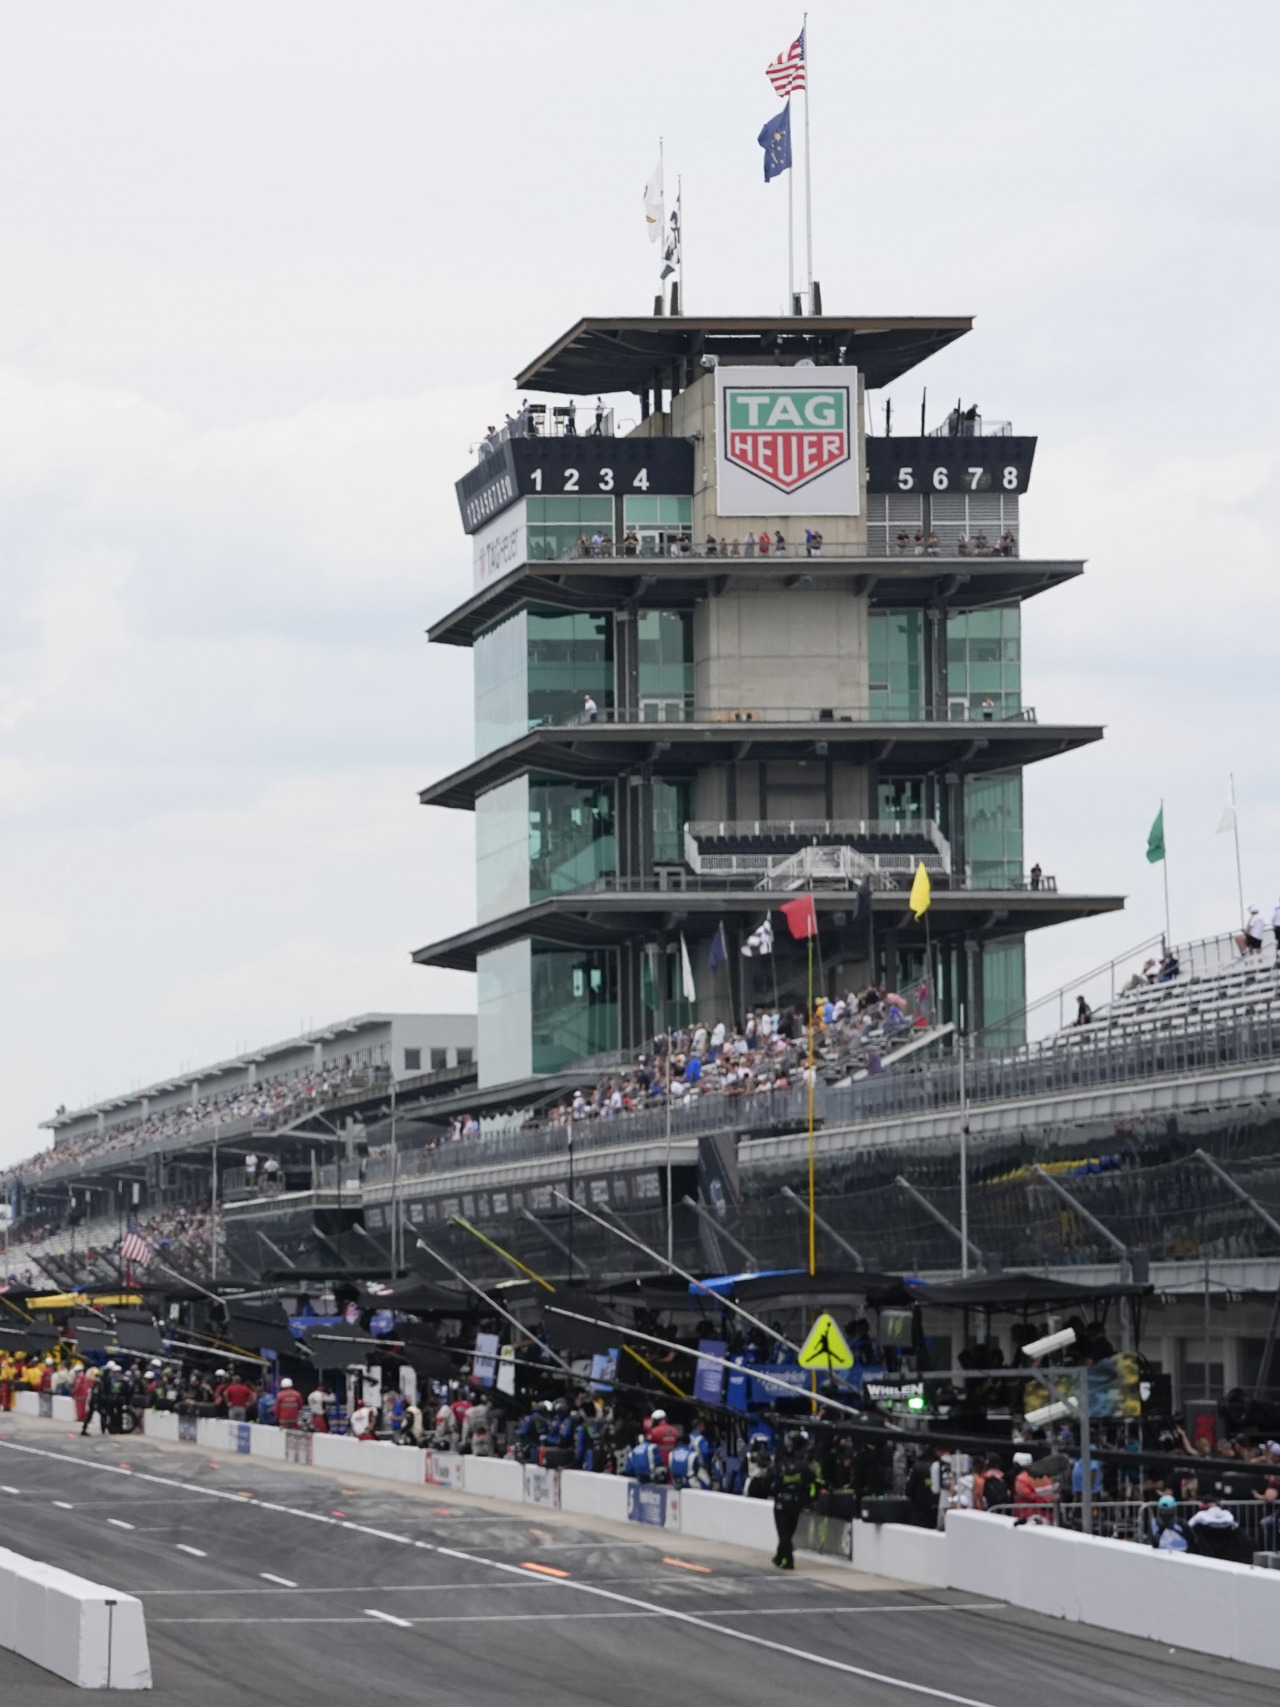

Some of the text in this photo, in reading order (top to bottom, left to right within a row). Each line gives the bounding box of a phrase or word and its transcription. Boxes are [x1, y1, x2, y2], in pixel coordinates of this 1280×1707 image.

[736, 395, 836, 427] TAG
[734, 435, 841, 483] HEUER
[530, 467, 650, 492] 1 2 3 4
[897, 466, 1018, 491] 5 6 7 8
[866, 1382, 924, 1395] WHELEN
